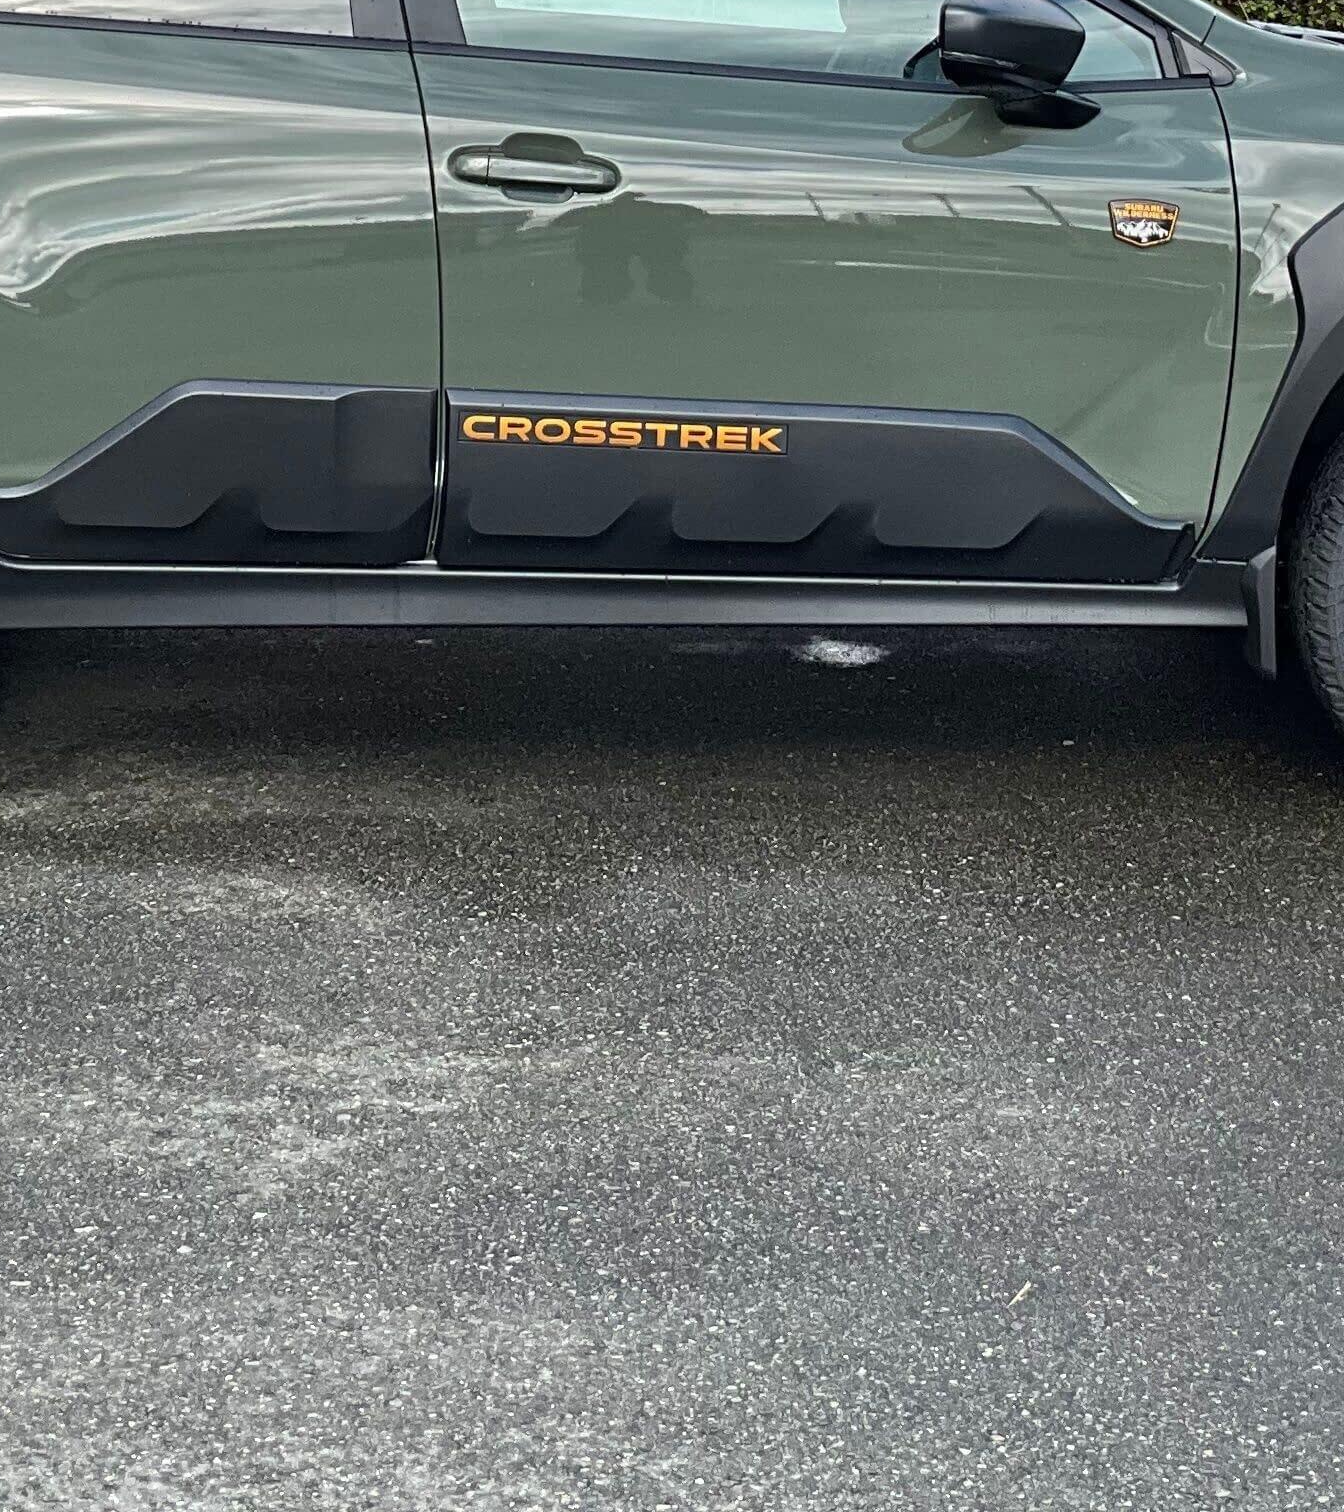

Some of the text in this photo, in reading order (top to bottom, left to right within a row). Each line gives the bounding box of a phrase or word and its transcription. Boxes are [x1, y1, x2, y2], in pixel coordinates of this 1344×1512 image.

[1113, 208, 1175, 220] WILDERNESS
[1125, 203, 1164, 213] SUBARU
[462, 414, 783, 453] CROSSTREK
